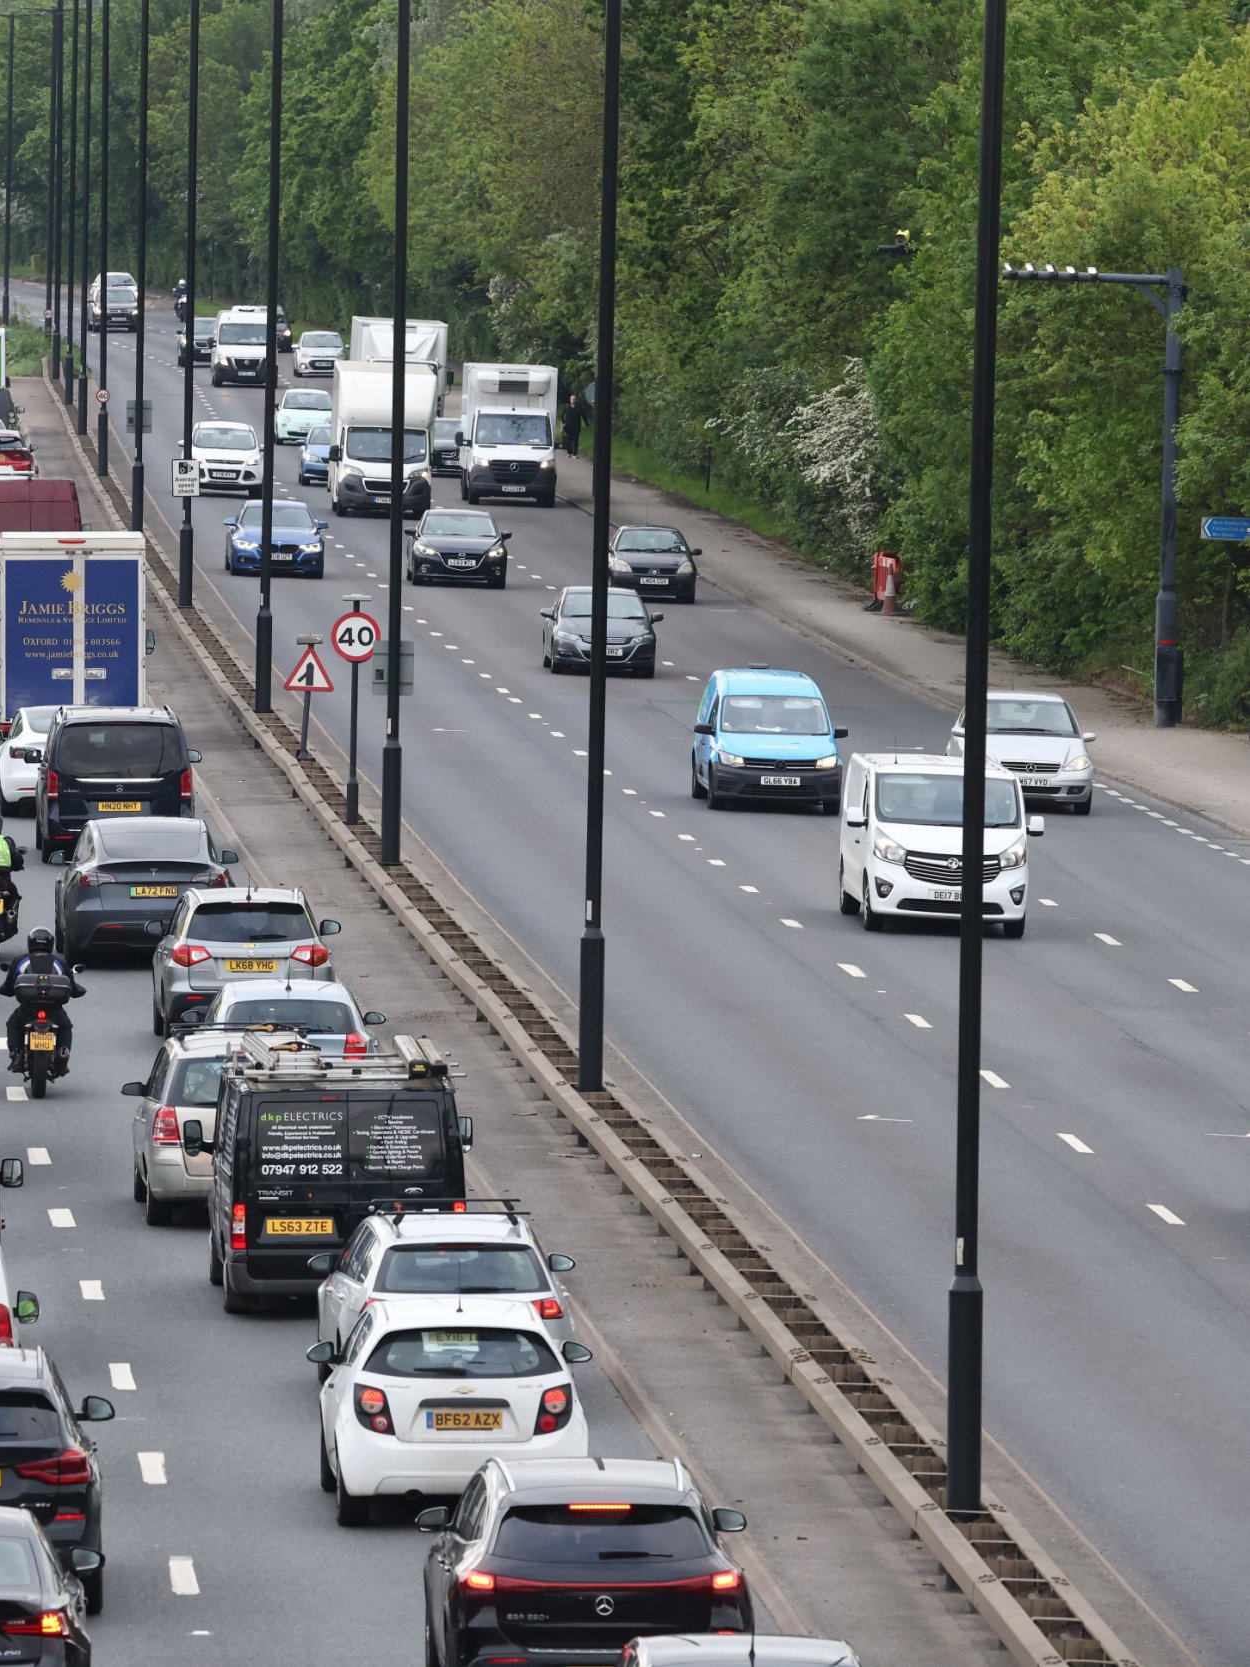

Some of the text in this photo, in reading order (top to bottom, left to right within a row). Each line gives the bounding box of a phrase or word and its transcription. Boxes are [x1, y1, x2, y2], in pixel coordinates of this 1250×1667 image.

[20, 600, 126, 615] JAMIE BRIGGS
[96, 616, 127, 624] LIMITED
[338, 627, 374, 646] 40
[24, 637, 121, 646] OXFORD 883566
[123, 802, 138, 810] NHT
[136, 886, 177, 895] LA72 FND
[934, 891, 952, 900] DE17
[230, 960, 274, 970] LK68 YHG
[260, 1112, 343, 1123] dkp ELECTRICS
[262, 1144, 342, 1152] www.dkpelectrics.co.uk
[262, 1152, 342, 1160] info@dkpelectrics.co.uk
[262, 1164, 343, 1175] 07947 912 522
[272, 1222, 328, 1233] LS63 ZTE
[436, 1414, 500, 1426] BF62 AZX
